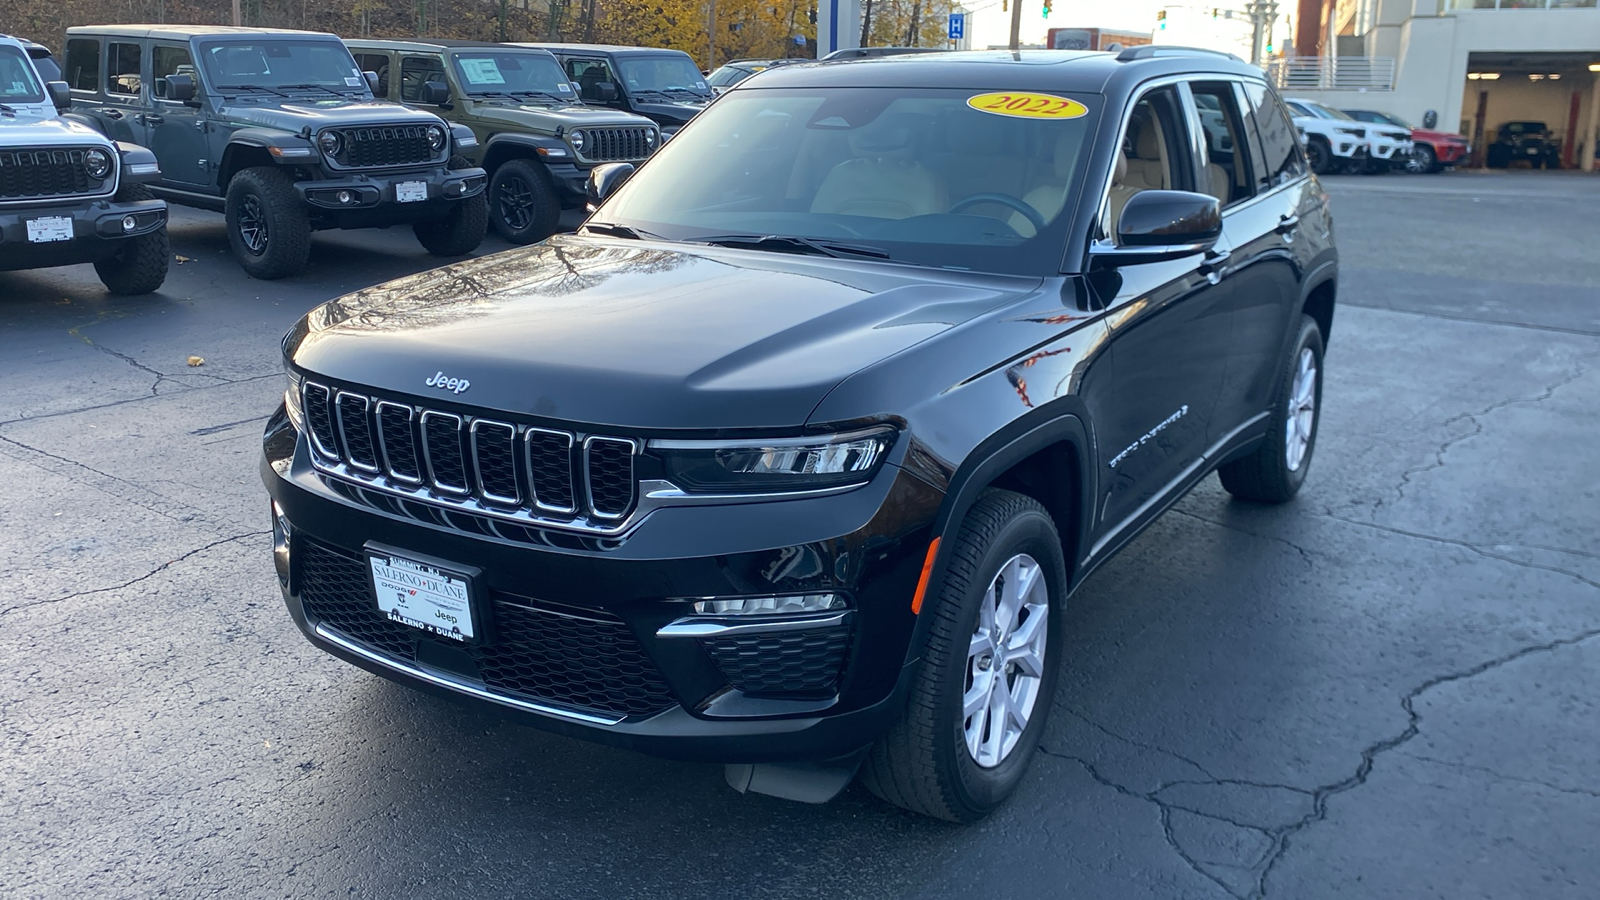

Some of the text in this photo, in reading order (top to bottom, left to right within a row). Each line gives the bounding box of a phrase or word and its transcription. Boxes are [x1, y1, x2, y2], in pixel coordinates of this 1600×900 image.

[952, 19, 961, 32] H
[983, 96, 1069, 114] 2022
[425, 371, 470, 395] Jeep
[374, 565, 422, 587] SALERNO
[426, 579, 465, 601] DUANE
[387, 612, 464, 642] SALERNO DUANE
[434, 609, 458, 625] Jeep
